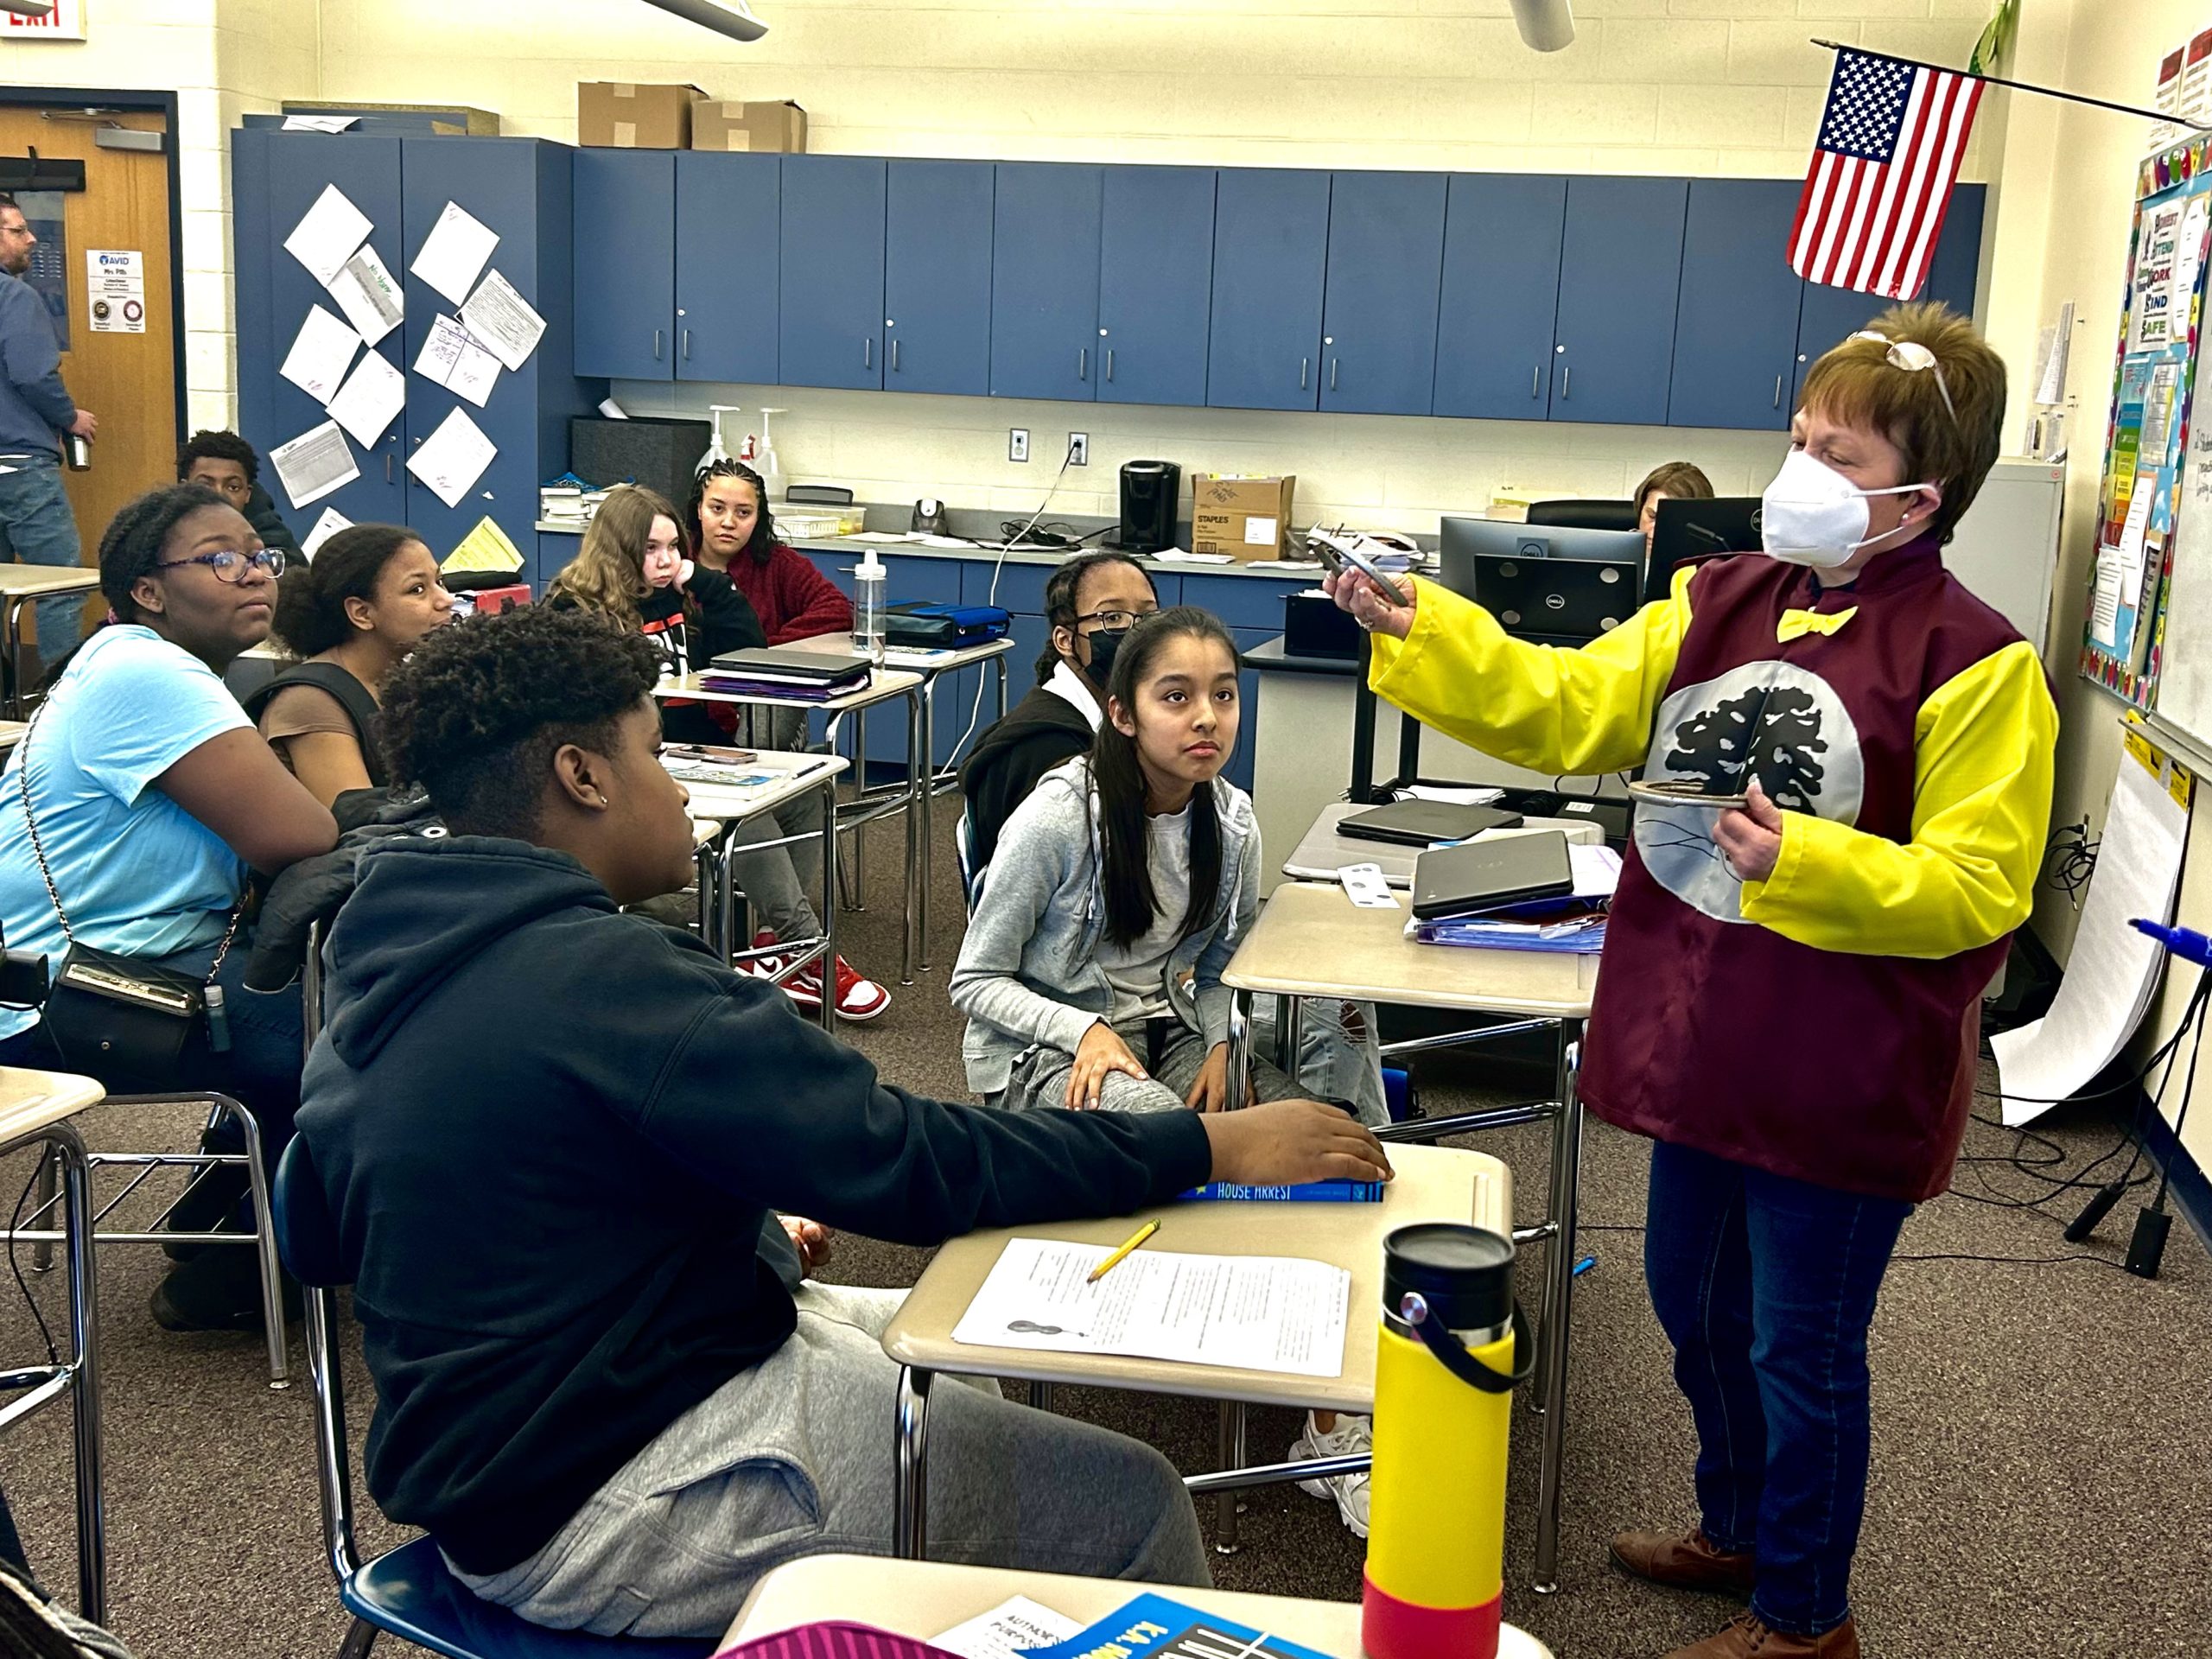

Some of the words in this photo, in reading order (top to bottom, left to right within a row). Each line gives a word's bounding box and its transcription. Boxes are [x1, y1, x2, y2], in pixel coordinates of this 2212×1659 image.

[109, 257, 130, 265] AVID
[2146, 268, 2171, 289] WORK
[2145, 294, 2168, 312] KIND
[2140, 320, 2166, 340] SAFE
[1198, 515, 1229, 524] STAPLES
[1217, 1182, 1250, 1200] HOUSE
[1254, 1185, 1290, 1200] ARREST
